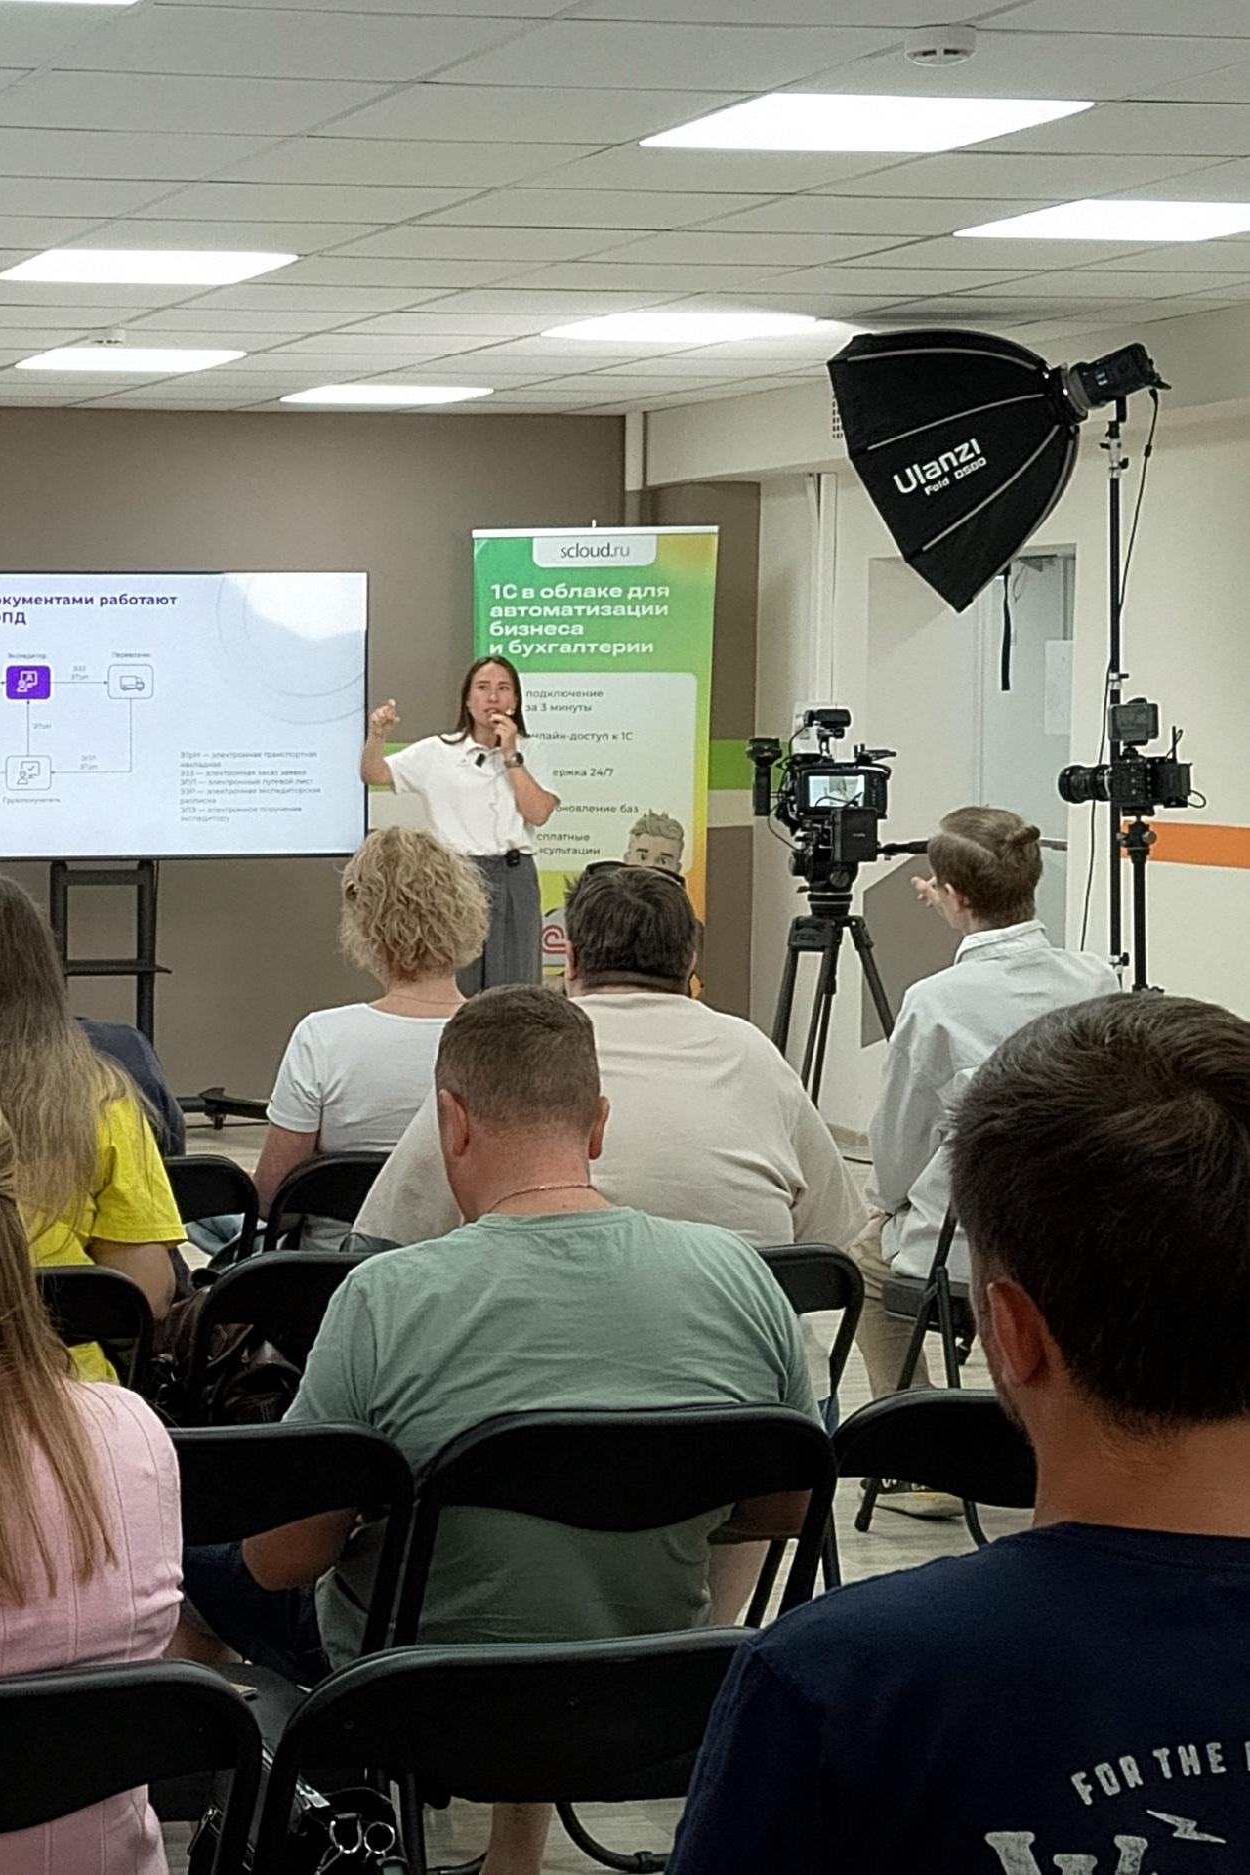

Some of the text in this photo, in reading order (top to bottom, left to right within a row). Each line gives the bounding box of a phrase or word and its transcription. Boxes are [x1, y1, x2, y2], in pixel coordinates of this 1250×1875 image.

[560, 542, 631, 559] scloud.ru
[522, 586, 535, 599] в
[540, 583, 623, 599] облаке
[628, 586, 670, 600] для
[100, 594, 178, 608] работают
[489, 604, 669, 618] автоматизации
[489, 620, 585, 636] бизнеса
[489, 639, 654, 658] и бухгалтерии
[526, 690, 604, 698] подключение
[526, 703, 593, 714] за 3 минуты
[530, 731, 609, 743] нлайн-доступ
[552, 768, 614, 778] ержка 24/7
[619, 803, 639, 814] баз
[536, 832, 590, 841] сплатные
[539, 847, 601, 856] сультации
[1070, 1755, 1144, 1806] FOR
[1152, 1742, 1227, 1779] THE
